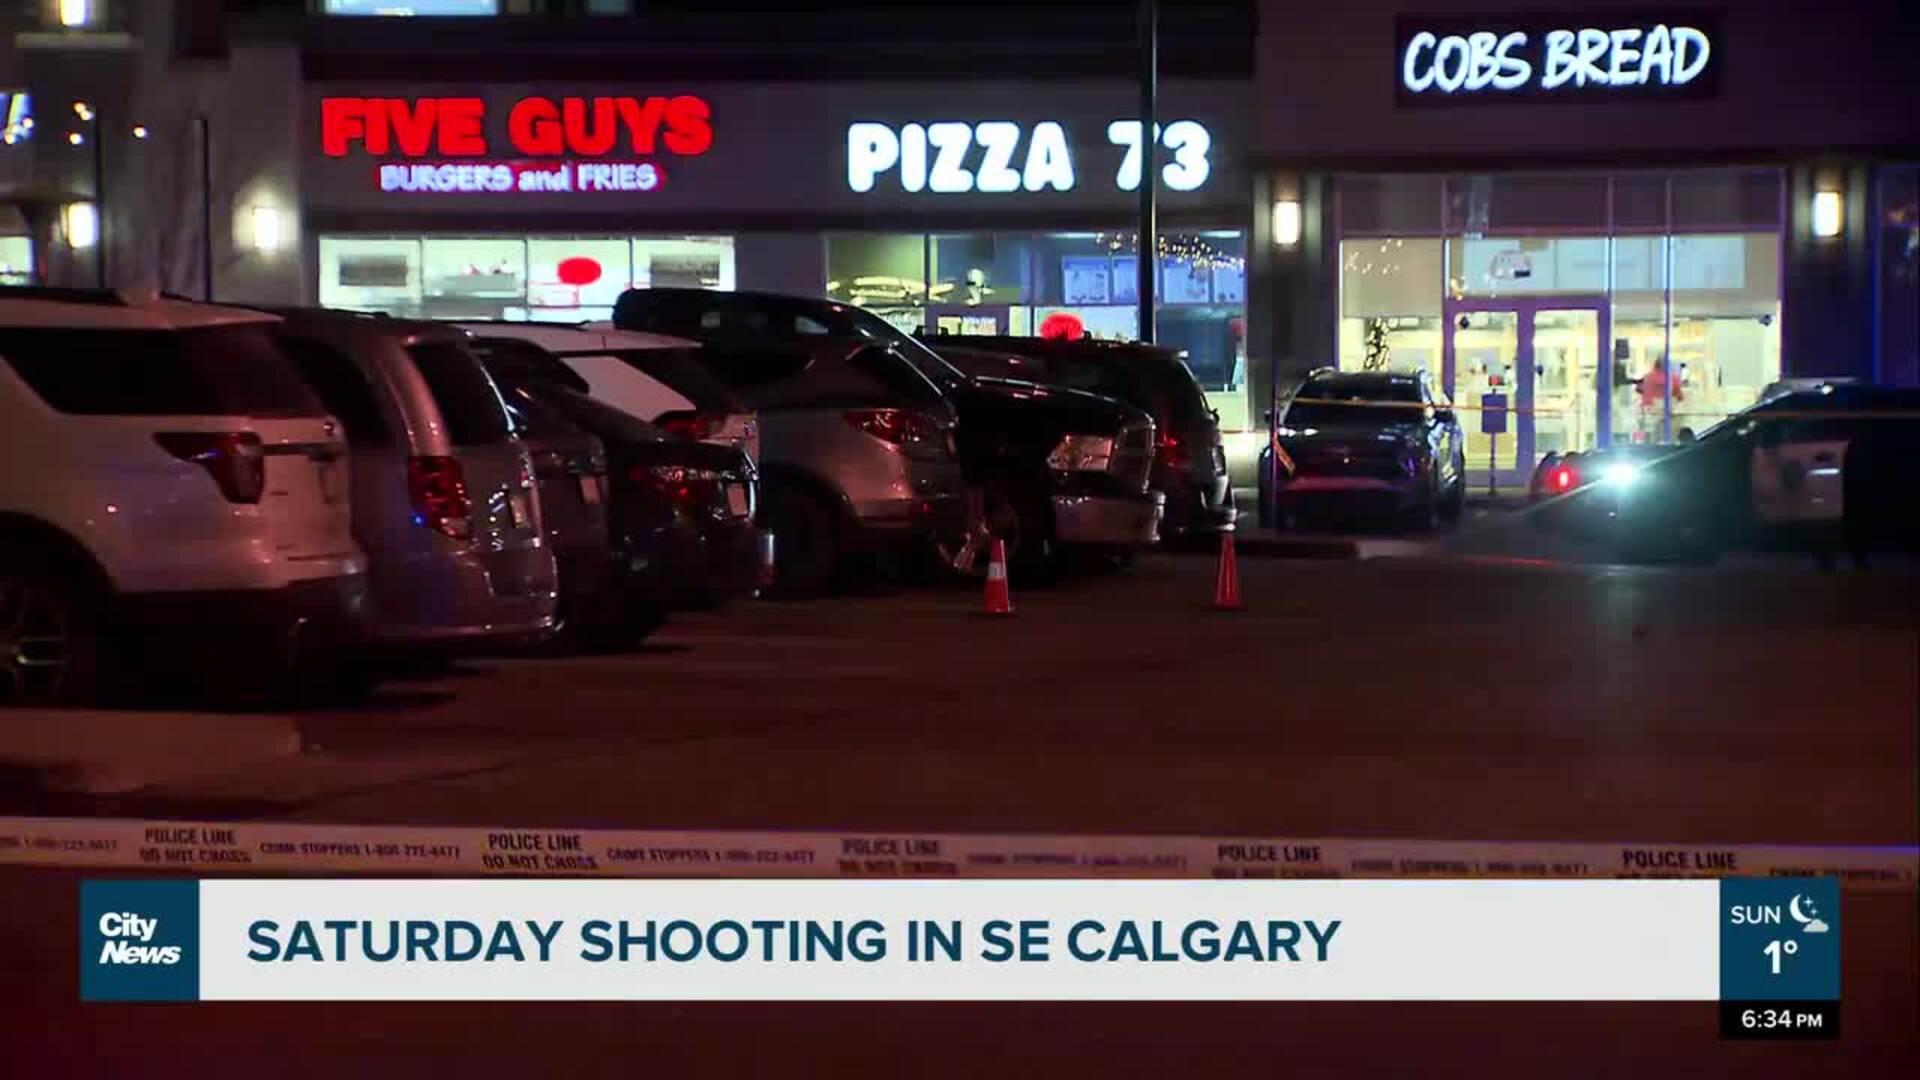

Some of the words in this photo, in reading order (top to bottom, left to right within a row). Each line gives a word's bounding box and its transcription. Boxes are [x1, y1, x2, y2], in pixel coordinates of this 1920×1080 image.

[1404, 31, 1531, 92] COBS
[1542, 24, 1711, 89] BREAD
[321, 97, 488, 157] FIVE
[508, 95, 713, 156] GUYS
[847, 120, 1075, 193] PIZZA
[1107, 119, 1212, 192] 73
[380, 164, 514, 192] BURGERS
[518, 165, 571, 192] and
[577, 164, 658, 191] FRIES
[144, 827, 197, 845] POLICE
[201, 829, 237, 846] LINE
[488, 832, 543, 851] POLICE
[547, 834, 583, 852] LINE
[164, 848, 194, 863] NOT
[842, 839, 899, 856] POLICE
[1217, 845, 1278, 863] POLICE
[1283, 845, 1322, 864] LINE
[482, 854, 505, 870] DO
[509, 854, 540, 870] NOT
[544, 855, 598, 871] CROSS
[1622, 849, 1690, 868] POLICE
[1695, 851, 1738, 871] LINE
